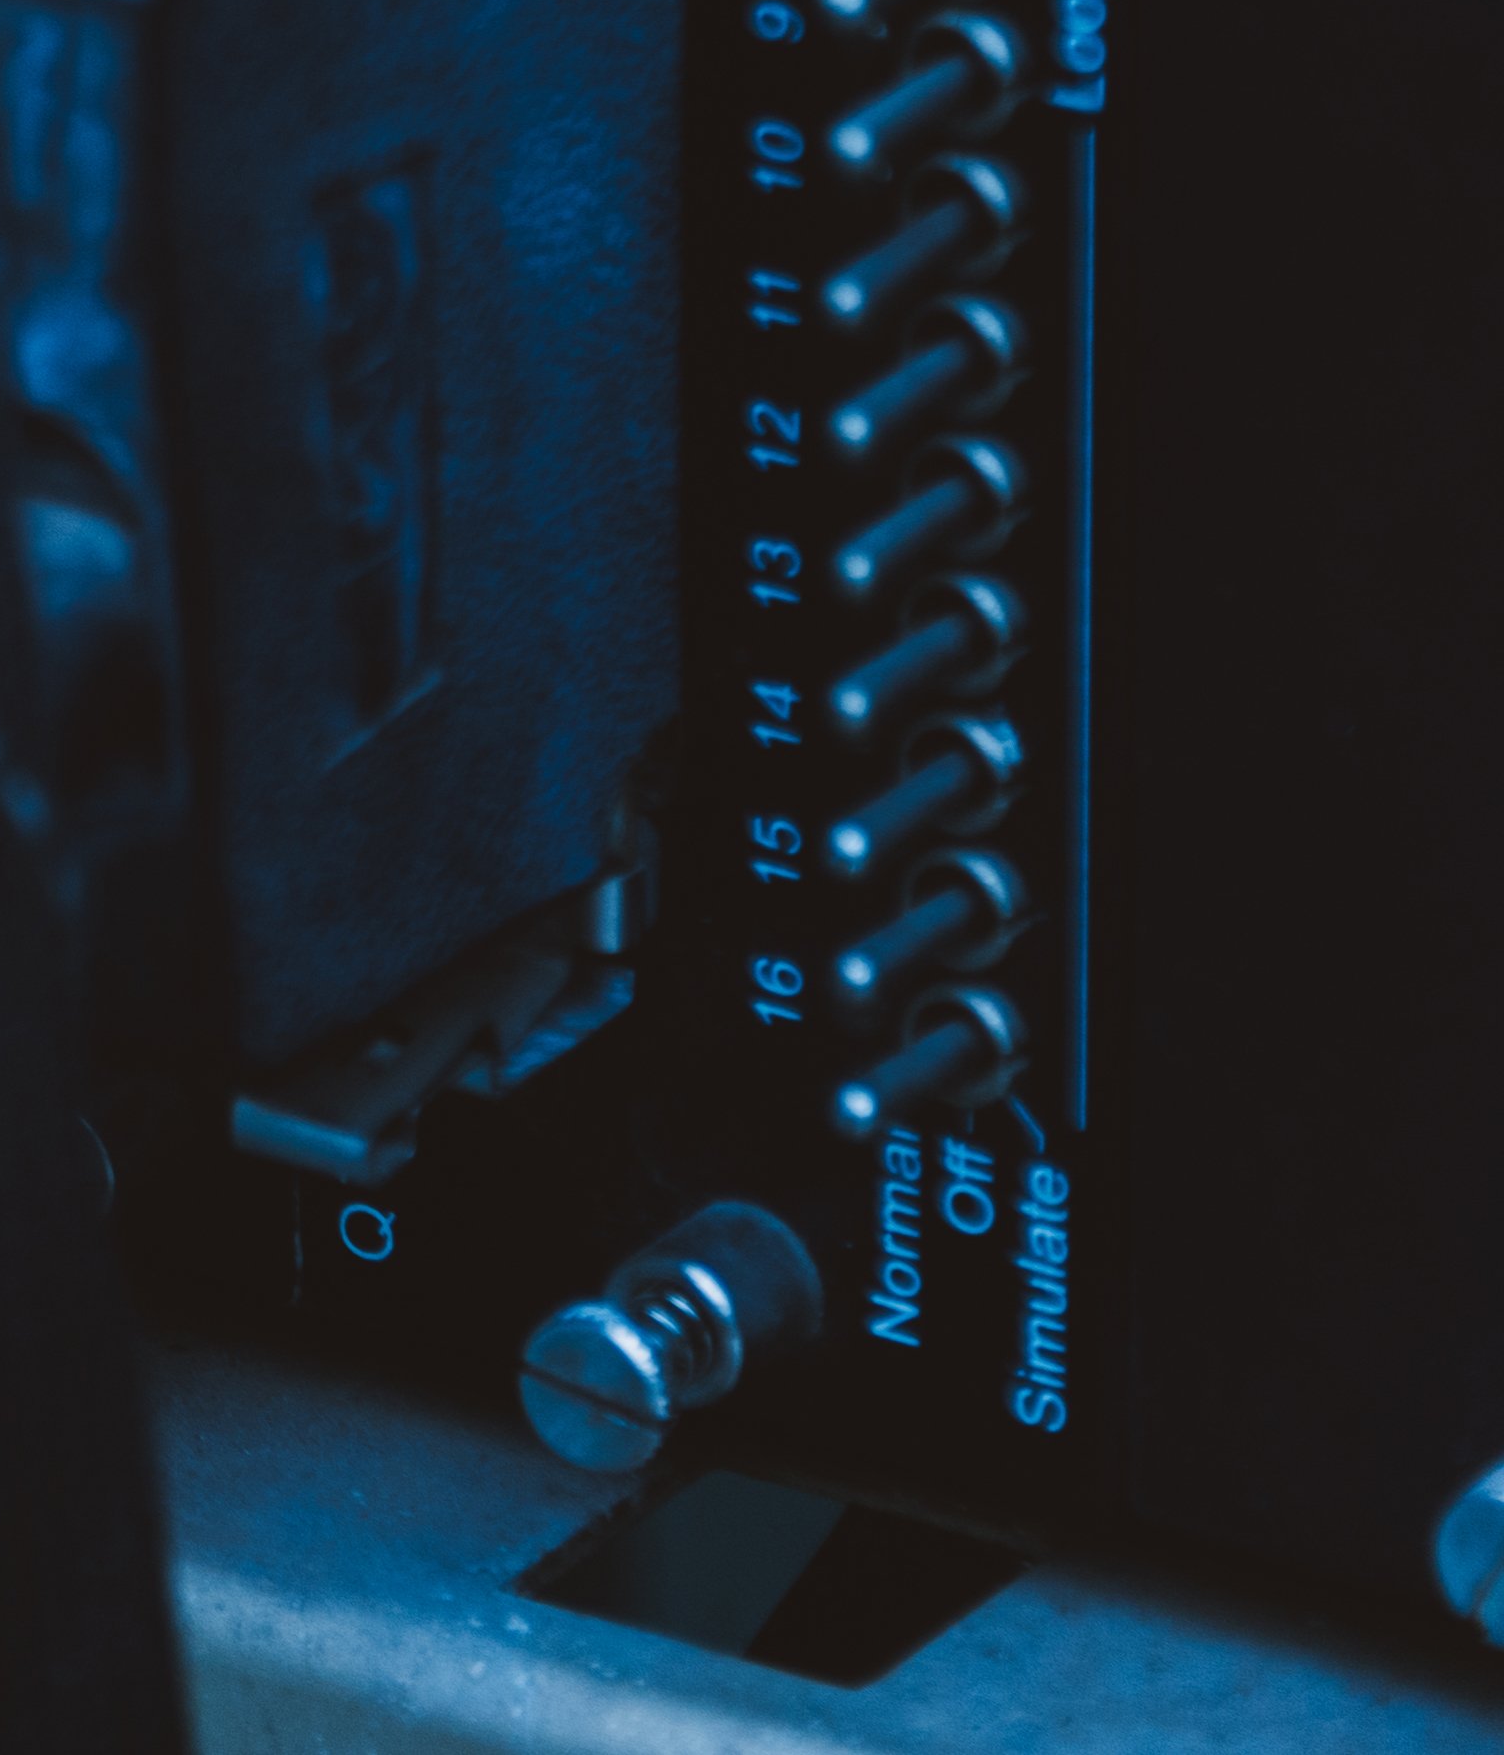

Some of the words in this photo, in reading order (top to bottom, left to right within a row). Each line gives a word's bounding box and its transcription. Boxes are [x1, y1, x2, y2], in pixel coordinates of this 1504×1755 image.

[750, 118, 806, 192] 10
[748, 268, 801, 329] 11
[746, 398, 802, 470] 12
[748, 536, 803, 607] 13
[750, 679, 802, 748] 14
[749, 814, 804, 884] 15
[750, 954, 805, 1026] 16
[937, 1132, 997, 1238] Off
[337, 1201, 398, 1263] Q
[867, 1125, 924, 1349] Normal
[1007, 1154, 1072, 1435] Simulate
